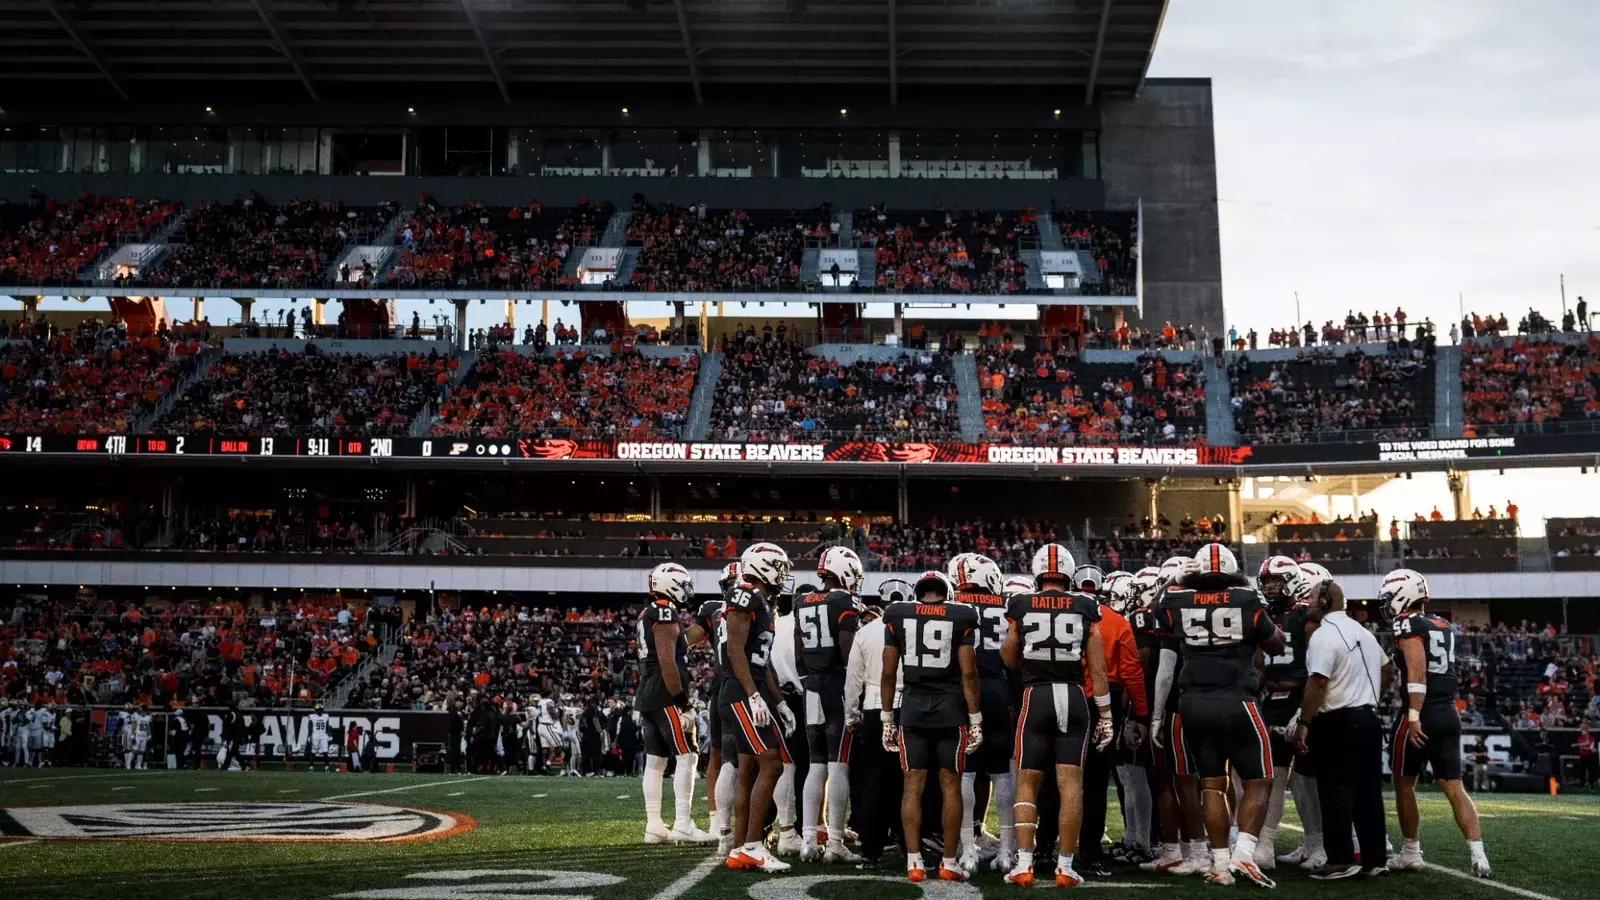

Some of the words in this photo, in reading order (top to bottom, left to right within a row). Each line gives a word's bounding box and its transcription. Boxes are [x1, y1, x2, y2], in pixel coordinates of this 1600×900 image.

[25, 436, 42, 452] 14
[77, 439, 98, 450] DOWN
[105, 436, 126, 454] 4TH
[176, 436, 185, 454] 2
[221, 441, 238, 452] BALL
[238, 441, 248, 452] ON
[260, 437, 274, 456] 13
[308, 438, 329, 456] 9:11
[370, 438, 392, 457] 2ND
[617, 443, 687, 459] OREGON
[690, 444, 742, 460] STATE
[745, 444, 824, 461] BEAVERS
[1378, 442, 1392, 451] TO
[1392, 441, 1411, 451] THE
[1411, 440, 1438, 450] VIDEO
[1438, 439, 1469, 449] BOARD
[1469, 438, 1488, 448] FOR
[1488, 437, 1515, 447] SOME
[988, 447, 1058, 463] OREGON
[1062, 447, 1114, 464] STATE
[1118, 448, 1198, 465] BEAVERS
[1379, 451, 1417, 461] SPECIAL
[731, 588, 752, 608] 36
[1031, 596, 1073, 609] RATLIFF
[658, 608, 672, 621] 13
[915, 604, 947, 616] YOUNG
[798, 604, 835, 649] 51
[1180, 607, 1243, 646] 59
[1393, 618, 1412, 636] 54
[903, 618, 954, 668] 19
[1022, 612, 1084, 661] 29
